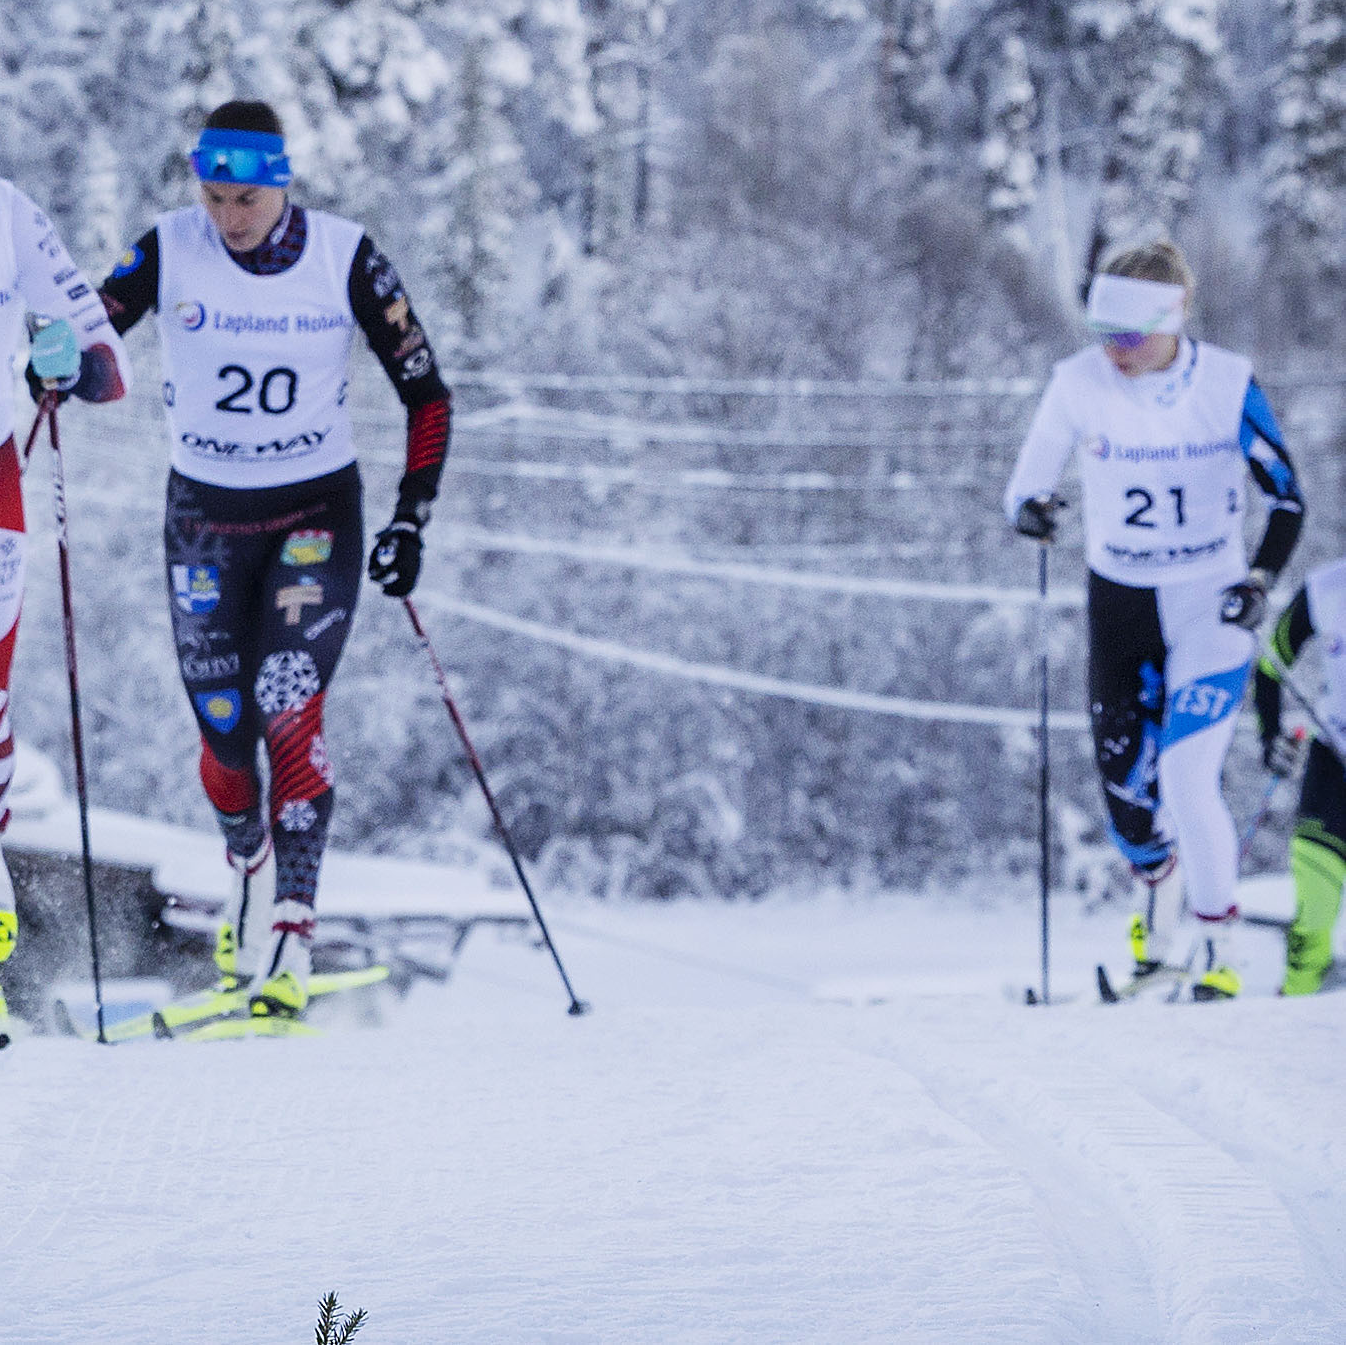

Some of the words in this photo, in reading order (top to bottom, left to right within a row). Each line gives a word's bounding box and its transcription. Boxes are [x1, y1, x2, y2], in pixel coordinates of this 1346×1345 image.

[213, 310, 289, 335] Lapland
[216, 364, 297, 414] 20
[1125, 487, 1185, 529] 21
